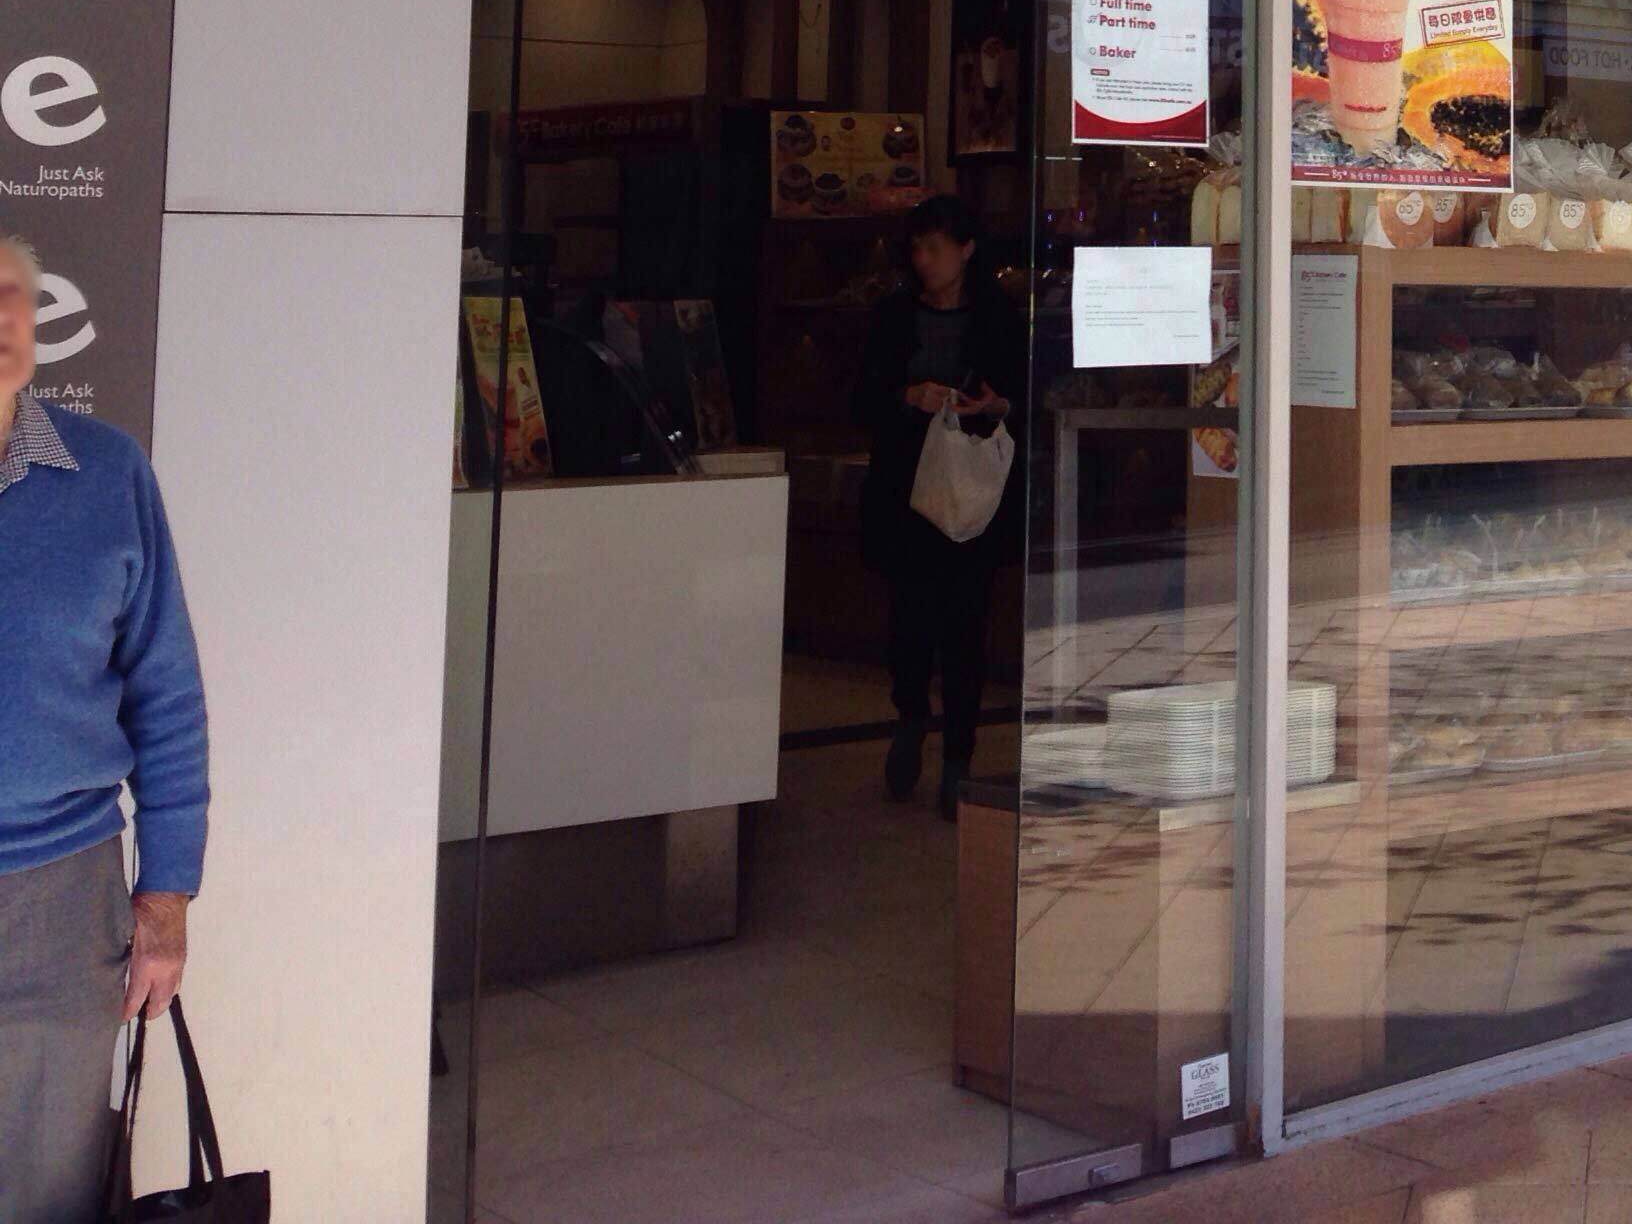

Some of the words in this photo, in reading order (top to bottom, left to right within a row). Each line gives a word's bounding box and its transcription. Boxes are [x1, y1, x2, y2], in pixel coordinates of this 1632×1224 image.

[1100, 14, 1127, 27] Part
[1129, 15, 1156, 30] time
[1100, 45, 1137, 60] Baker
[37, 164, 70, 183] Just
[72, 165, 104, 182] Ask
[0, 180, 104, 201] Naturopaths
[62, 383, 94, 399] Ask
